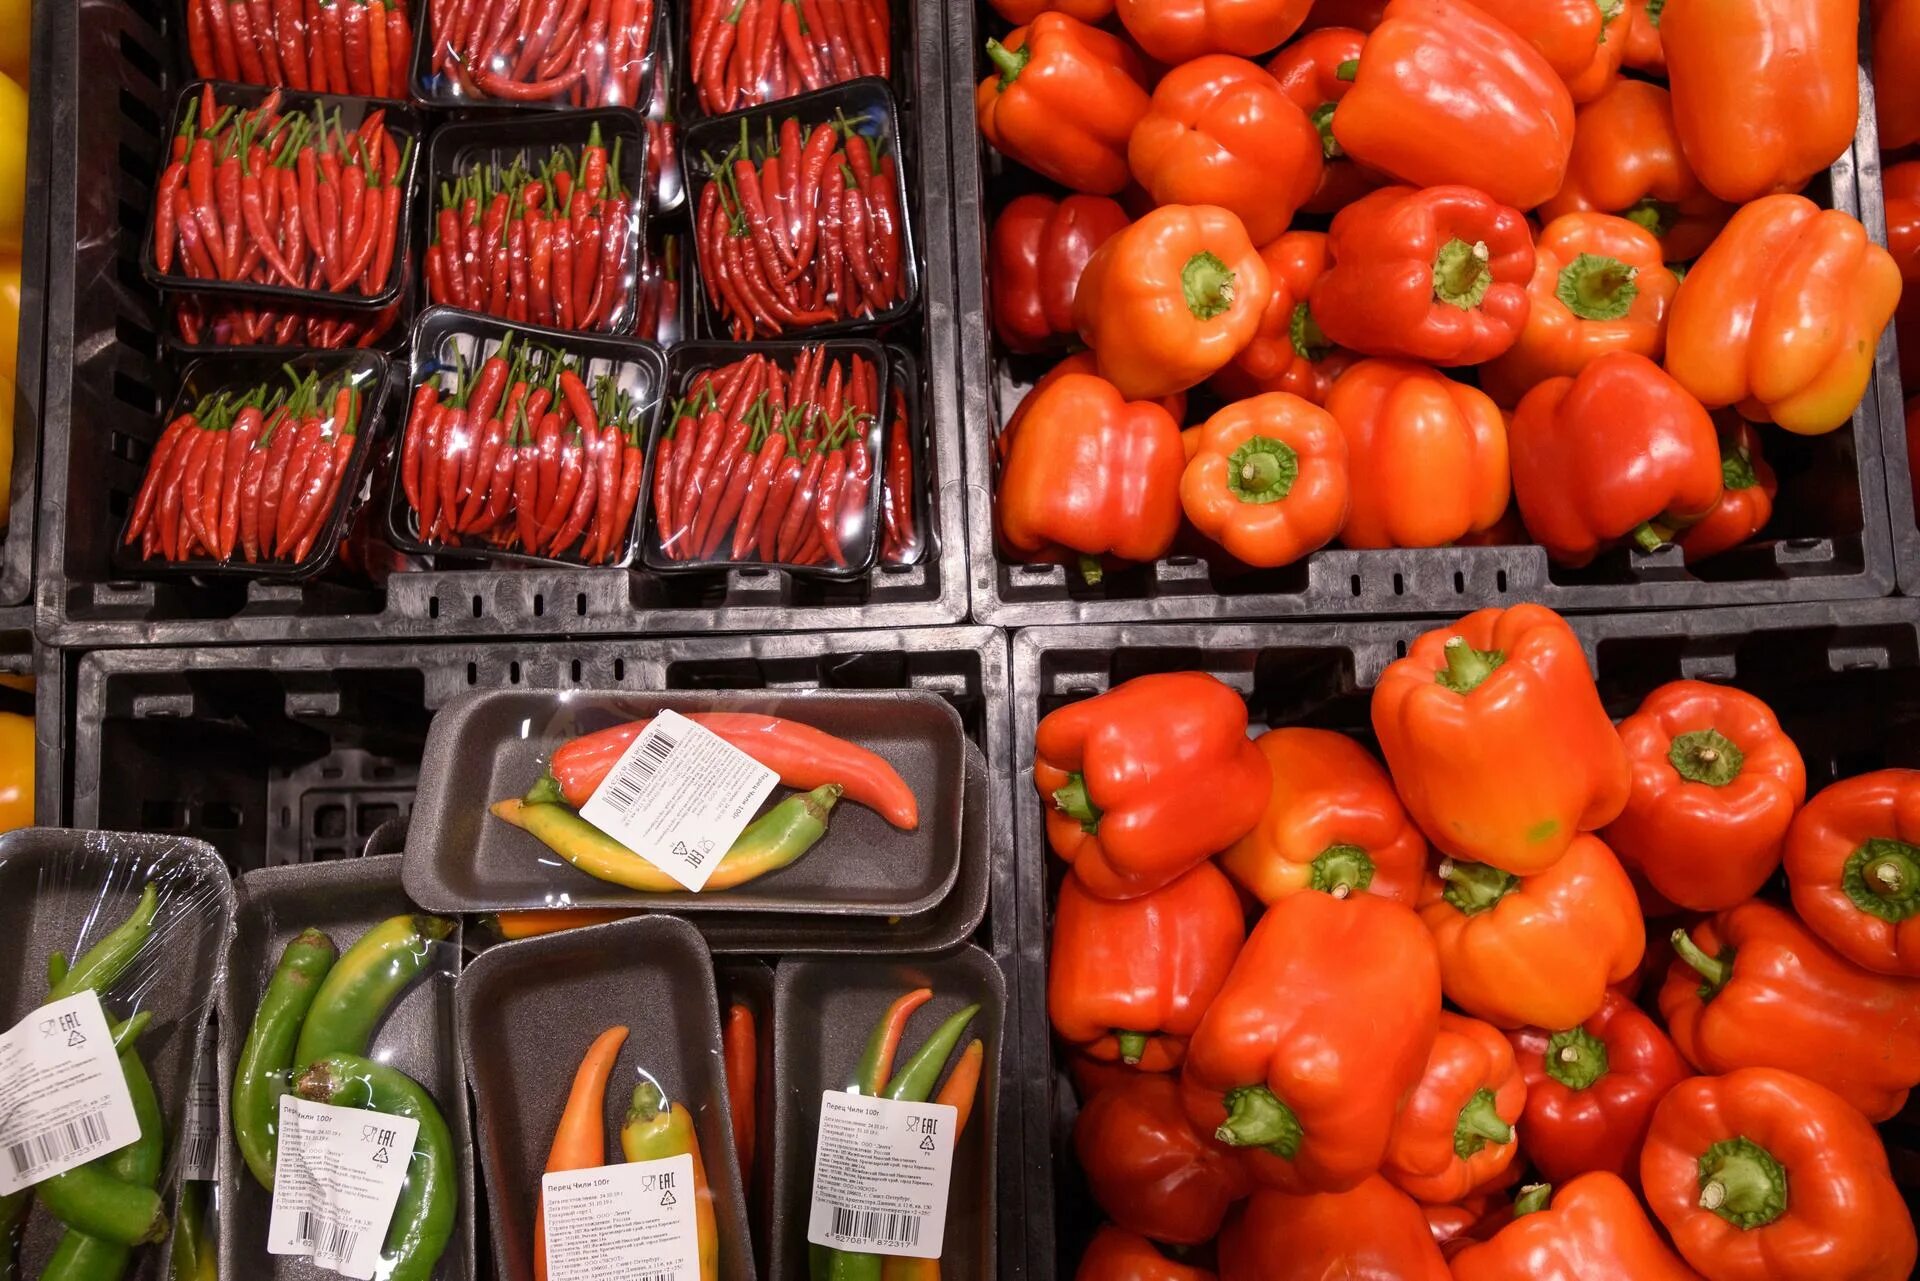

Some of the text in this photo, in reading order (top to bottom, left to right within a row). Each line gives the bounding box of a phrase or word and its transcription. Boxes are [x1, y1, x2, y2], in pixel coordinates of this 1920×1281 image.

[730, 770, 769, 820] Перец Чили 100г
[683, 848, 705, 869] EAC
[58, 1011, 82, 1032] EAC
[826, 1102, 880, 1116] Перец Чили 100г
[920, 1117, 938, 1135] EAC
[377, 1126, 397, 1147] EAC
[547, 1178, 610, 1193] Перец Чили 100г
[657, 1171, 676, 1190] EAC
[834, 1234, 867, 1245] 627081
[876, 1237, 910, 1248] 872317
